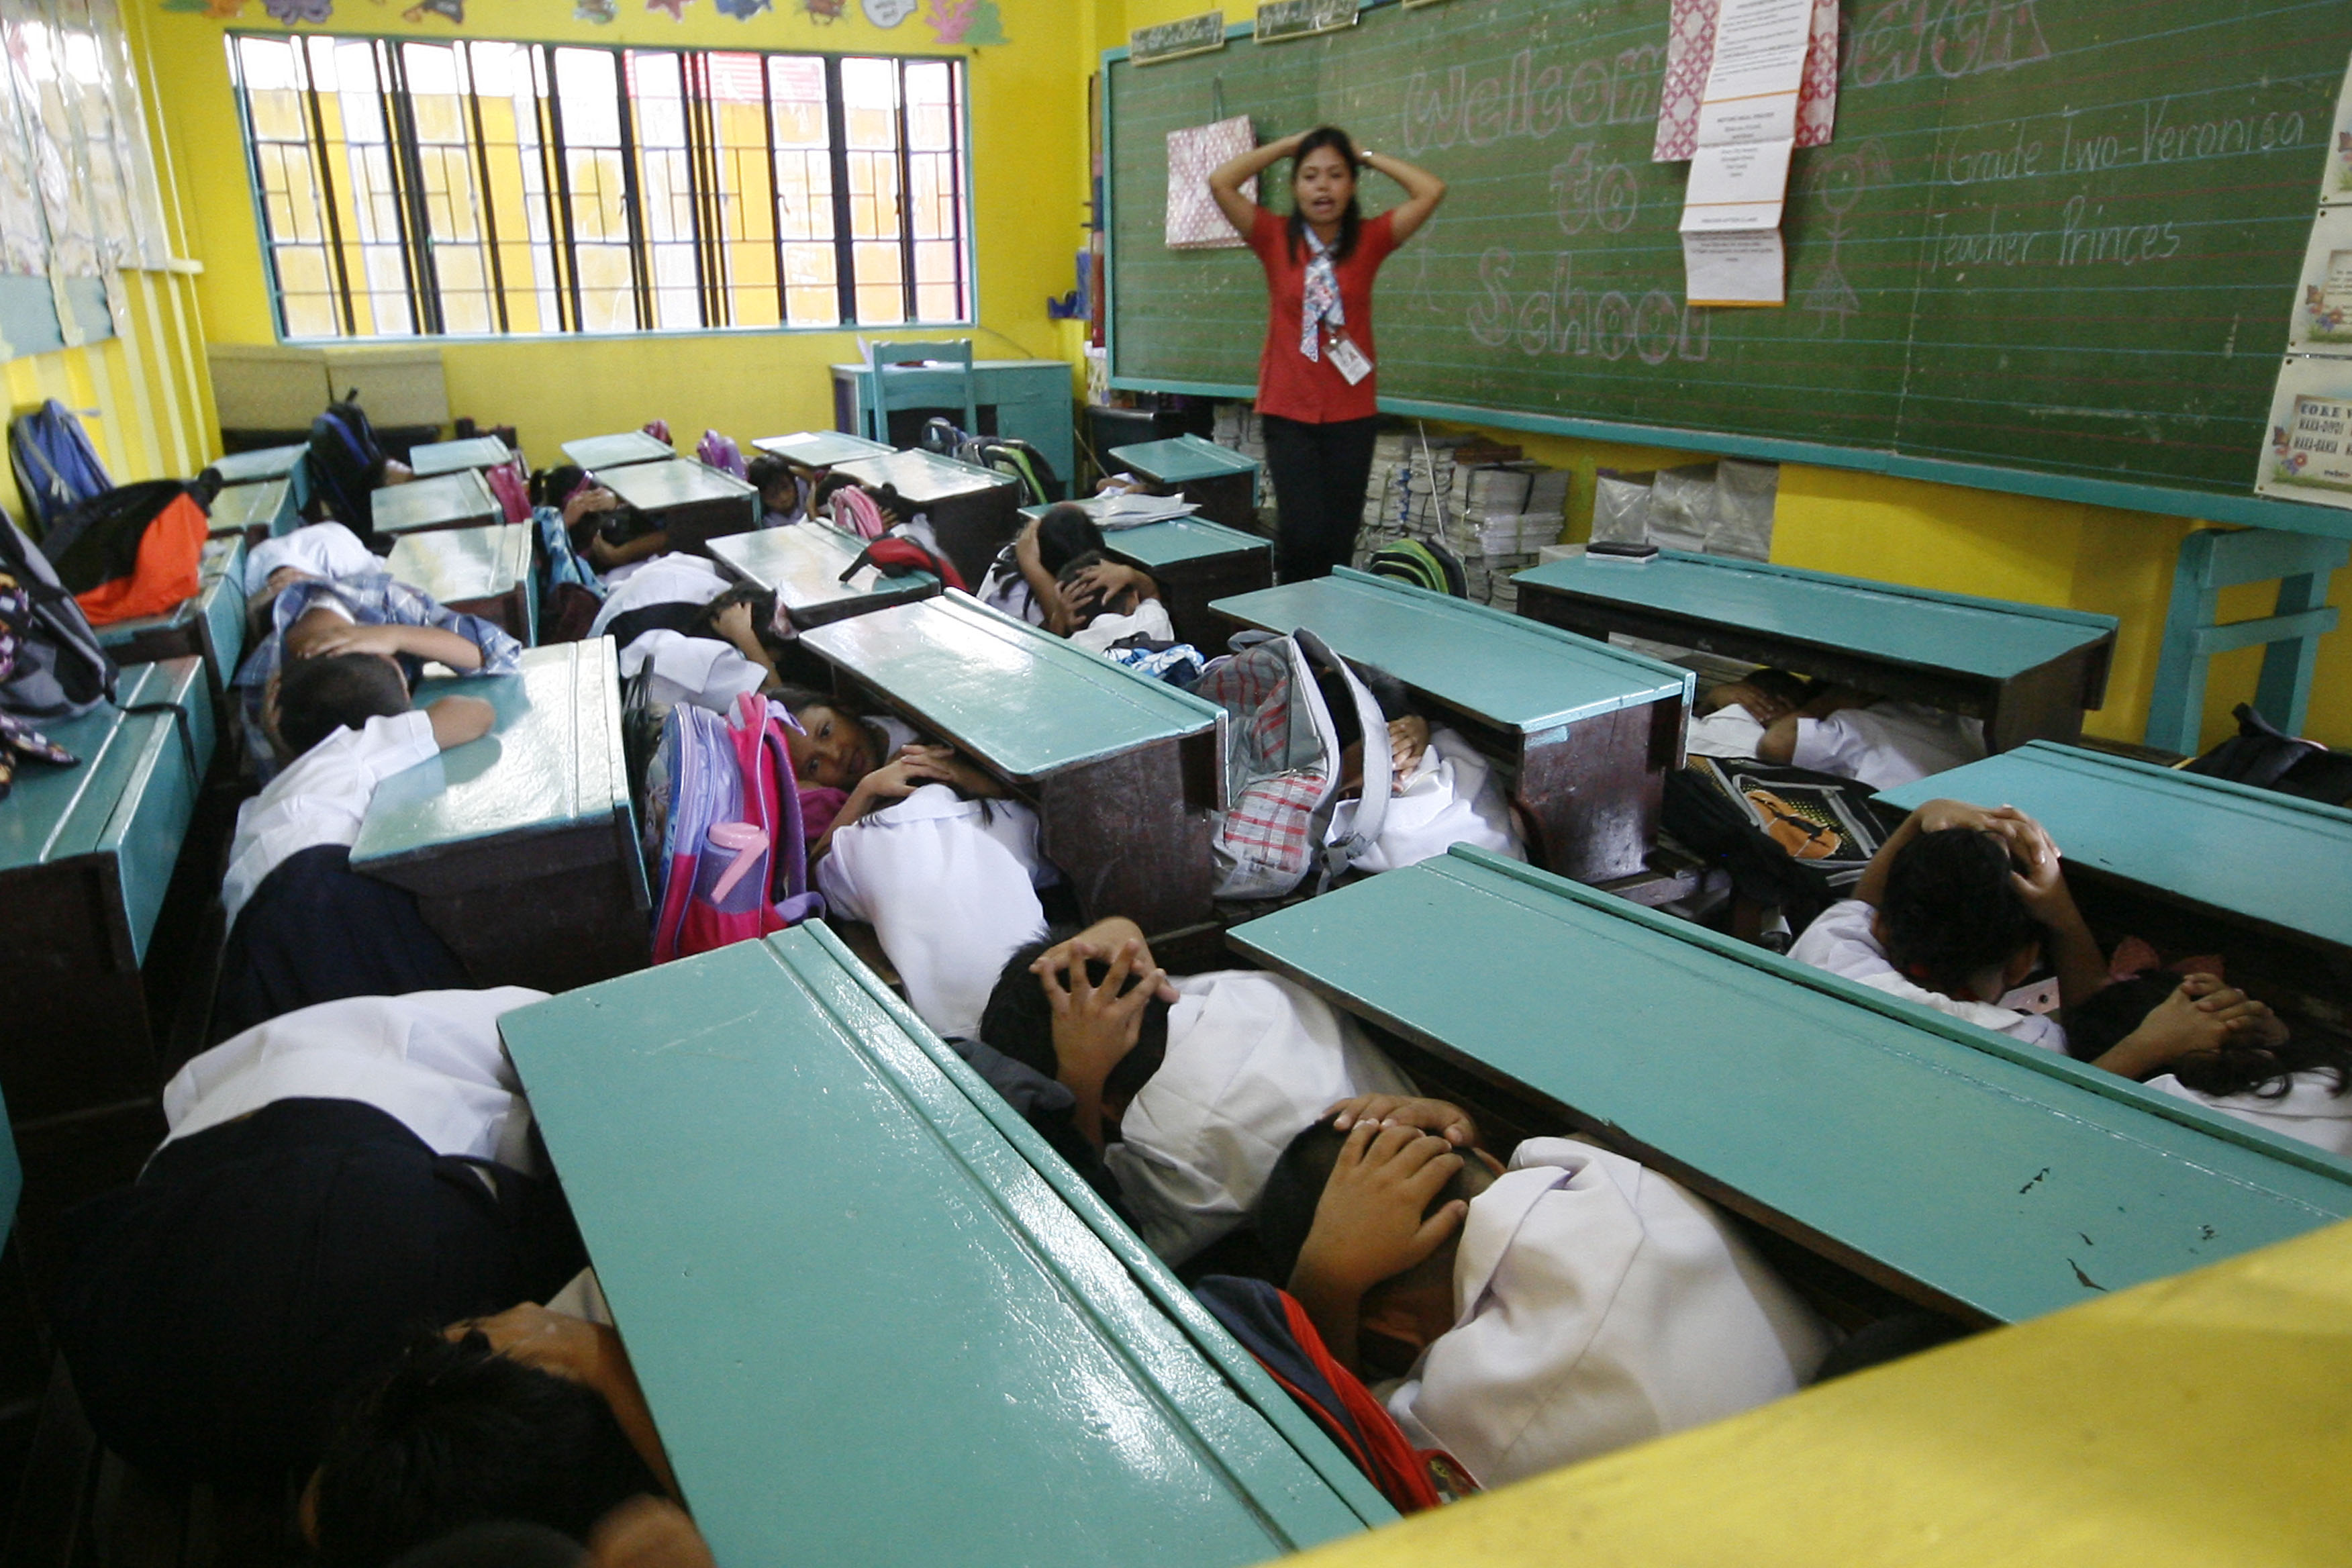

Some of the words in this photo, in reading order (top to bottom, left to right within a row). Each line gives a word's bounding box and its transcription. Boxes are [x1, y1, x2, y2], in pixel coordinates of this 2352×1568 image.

[1404, 43, 1666, 156] Welcom
[1549, 139, 1638, 236] to
[1947, 119, 2043, 185] Grade
[1932, 203, 2041, 273] Teacher
[2059, 195, 2181, 266] Princes
[1466, 246, 1710, 365] School
